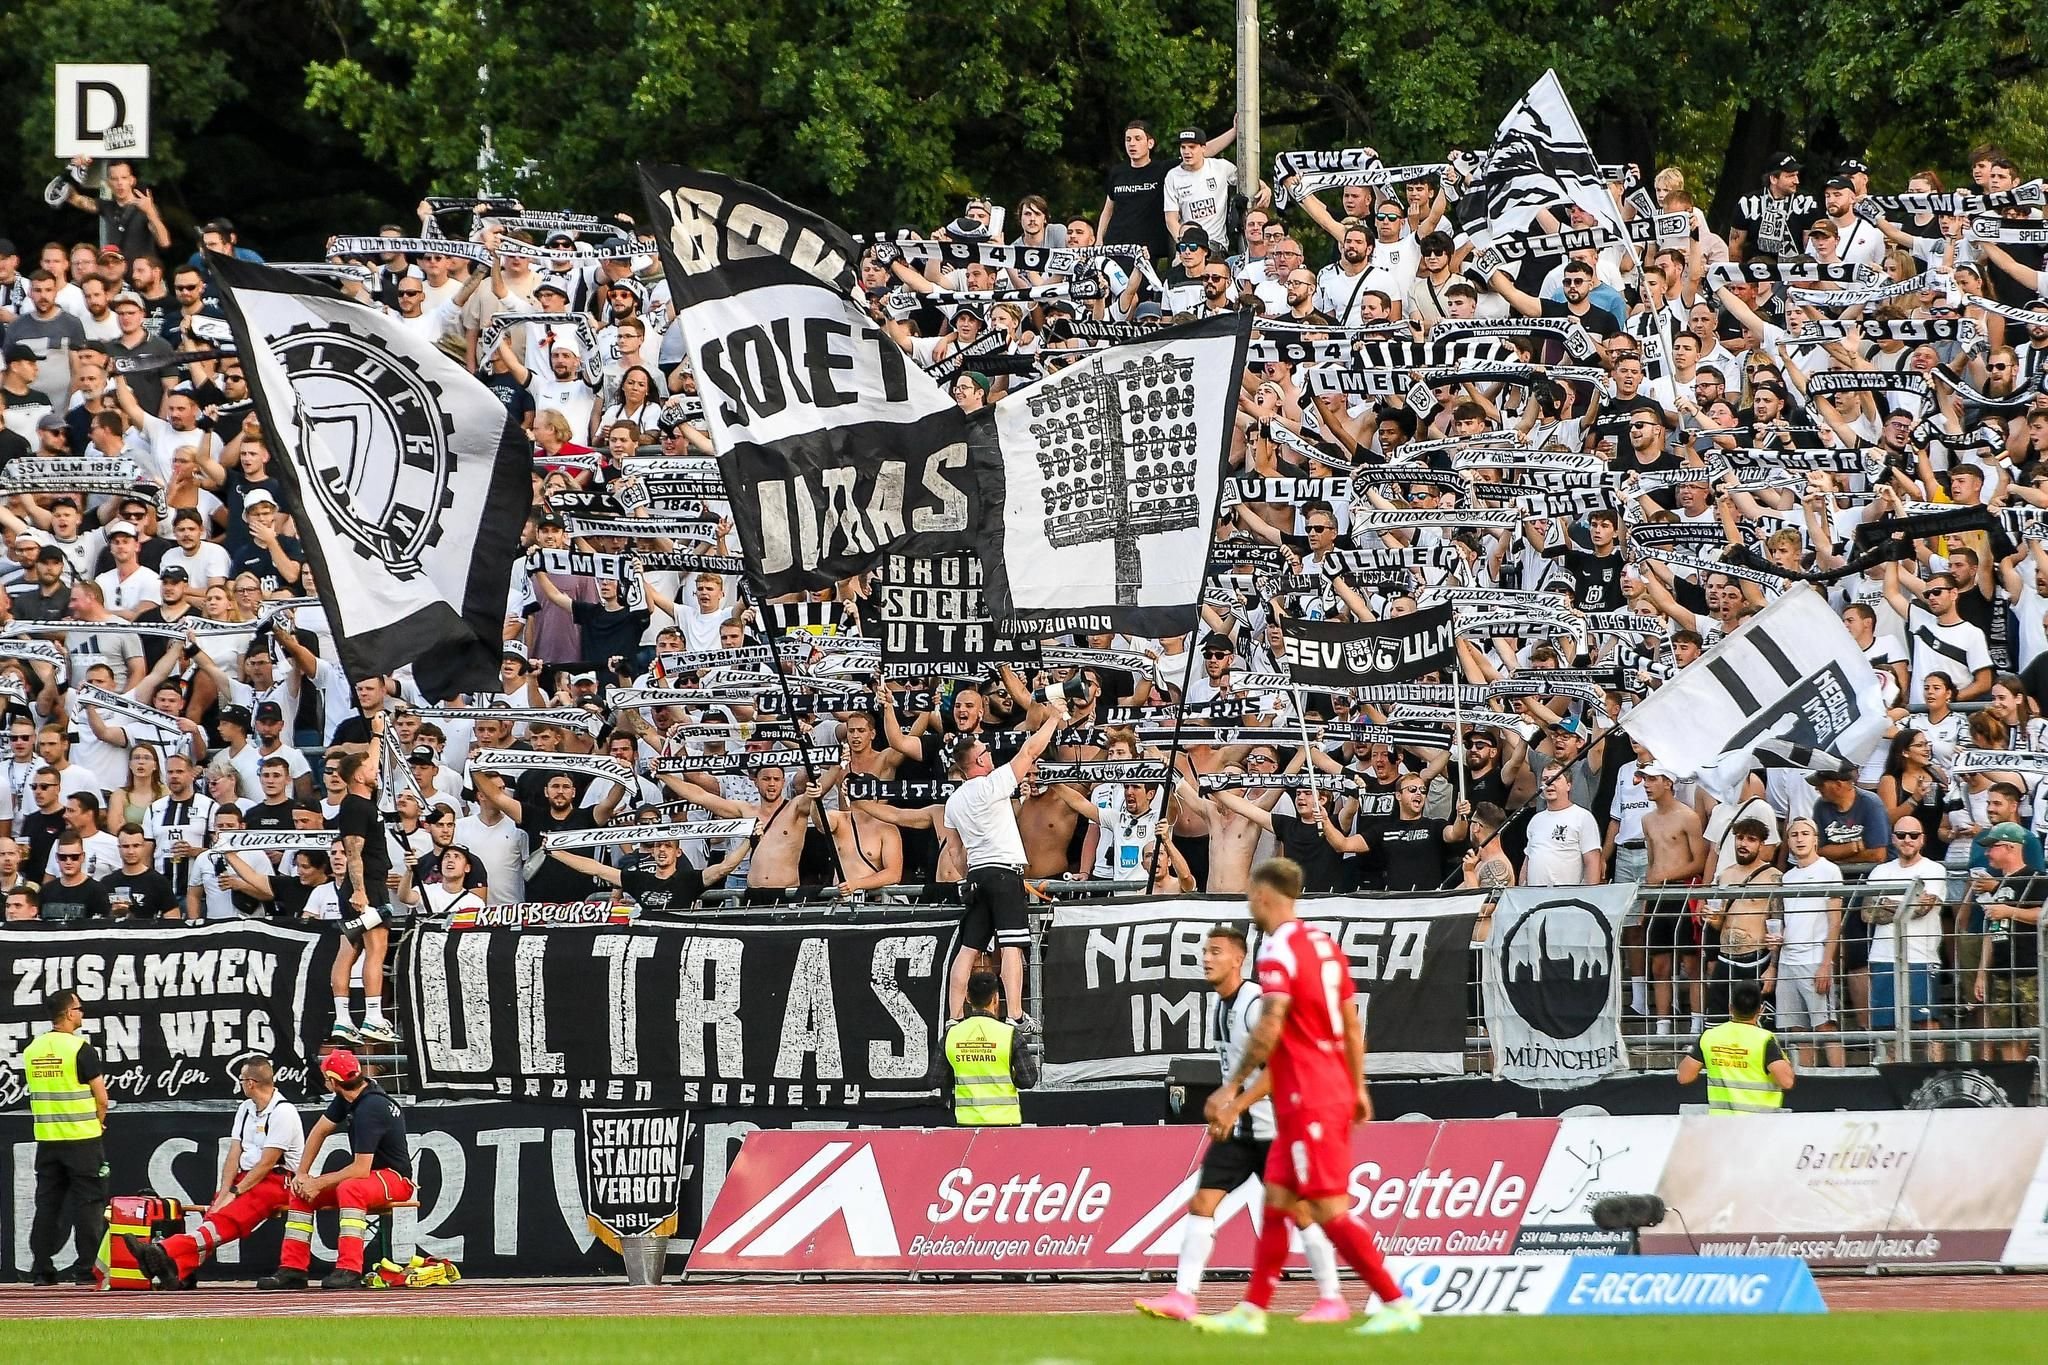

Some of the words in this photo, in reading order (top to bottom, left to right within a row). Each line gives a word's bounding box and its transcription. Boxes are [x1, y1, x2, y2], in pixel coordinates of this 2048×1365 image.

[76, 80, 126, 140] D
[1189, 198, 1214, 210] LIQUI
[1191, 206, 1216, 219] MOLY
[2019, 230, 2047, 241] SPIELT
[360, 237, 385, 250] ULM
[421, 240, 477, 257] FUSSBALL
[913, 242, 1041, 268] 1846
[1714, 262, 1846, 280] 1846
[1454, 319, 1483, 330] ULM
[1515, 317, 1570, 334] FUSSBALL
[1857, 373, 1887, 388] 2023
[1893, 374, 1904, 389] 3.
[1904, 374, 1928, 394] LIGA
[18, 463, 46, 475] SSV
[50, 462, 83, 473] ULM
[89, 461, 122, 472] 1846
[1731, 449, 1858, 472] ULMER
[649, 484, 674, 495] SSV
[675, 484, 702, 494] ULM
[1353, 474, 1372, 490] SSV
[1373, 471, 1396, 482] ULM
[1396, 472, 1418, 481] 1846
[663, 500, 702, 513] 1846
[1370, 510, 1445, 525] Münster
[663, 525, 691, 535] ULM
[692, 525, 714, 538] SSV
[1633, 526, 1690, 540] FUSSBALL
[668, 552, 699, 567] 1846
[1325, 546, 1458, 573] ULMER
[1287, 574, 1312, 589] ULM
[1354, 571, 1409, 586] FUSSBALL
[1596, 614, 1627, 629] 1846
[1345, 640, 1371, 652] SSV
[1403, 619, 1454, 664] ULM
[699, 651, 733, 662] 1846
[739, 647, 768, 659] ULM
[1285, 638, 1343, 670] SSV
[1346, 649, 1372, 659] 1846
[883, 661, 969, 678] BROKEN
[760, 730, 779, 739] 1846
[1350, 733, 1394, 744] IMPERO
[658, 754, 740, 770] BROKEN
[1120, 858, 1138, 866] SWU
[475, 900, 614, 927] KAUFBEUREN
[13, 948, 279, 1006] ZUSAMMEN
[420, 931, 938, 1080] ULTRAS
[159, 1009, 277, 1059] WEG
[955, 1054, 997, 1063] STEWARD
[1503, 1041, 1620, 1071] MÜNCHEN
[1710, 1058, 1749, 1069] STEWARD
[157, 1059, 210, 1097] den
[496, 1076, 653, 1102] BROKEN
[684, 1082, 862, 1105] SOCIETY
[591, 1116, 680, 1147] SEKTION
[591, 1146, 677, 1178] STADION
[1795, 1143, 1912, 1171] Barfüßer
[594, 1174, 677, 1206] VERBOT
[926, 1166, 1112, 1226] Settele
[1347, 1160, 1526, 1221] Settele
[616, 1212, 650, 1229] BSU
[1445, 1228, 1508, 1254] GmbH
[1519, 1231, 1539, 1243] SSV
[1539, 1231, 1559, 1243] Ulm
[1559, 1231, 1580, 1243] 1846
[1581, 1231, 1614, 1243] Fußball
[1614, 1232, 1630, 1243] e.V.
[1700, 1232, 1942, 1259] www.barfuesser-brauhaus.de
[908, 1234, 1033, 1260] Bedachungen
[1034, 1233, 1094, 1257] GmbH
[1515, 1246, 1567, 1257] Gemeinsam
[1432, 1265, 1544, 1313] BITE
[1568, 1271, 1771, 1307] E-RECRUITING
